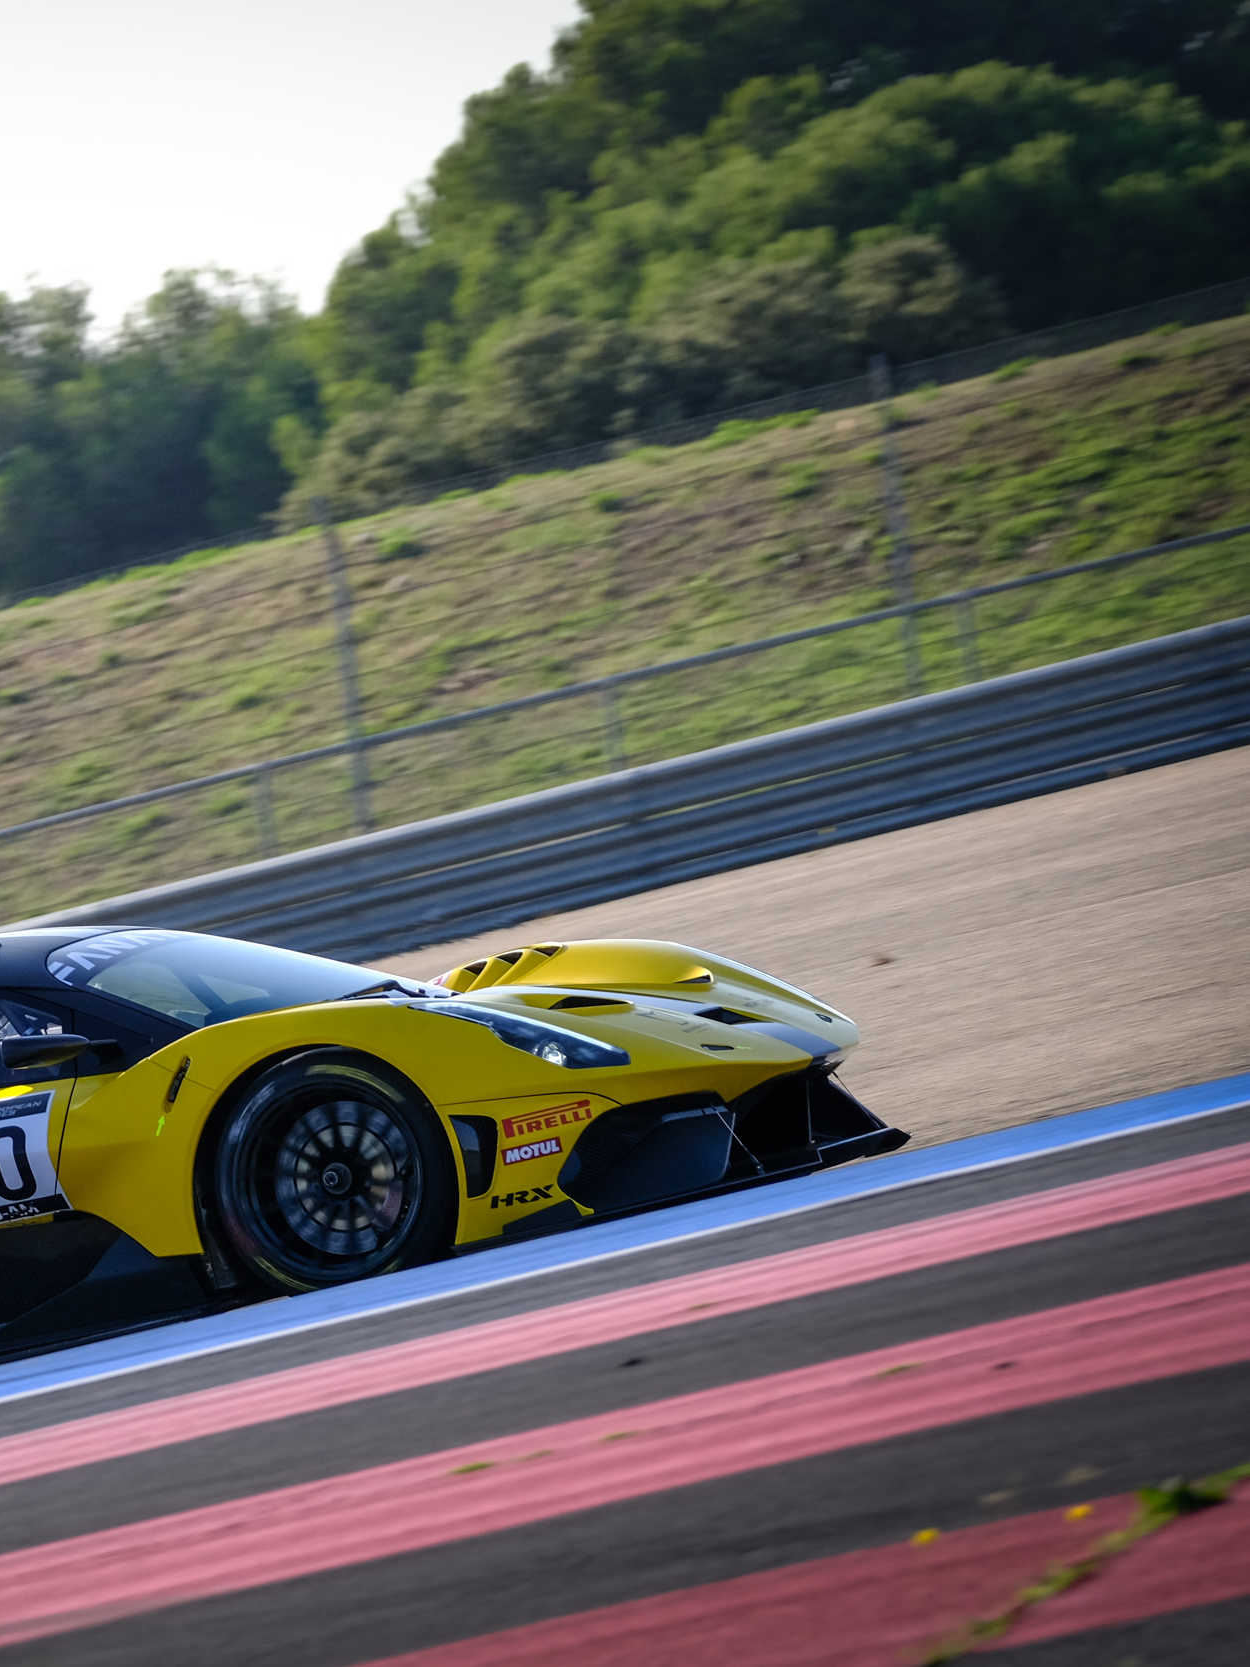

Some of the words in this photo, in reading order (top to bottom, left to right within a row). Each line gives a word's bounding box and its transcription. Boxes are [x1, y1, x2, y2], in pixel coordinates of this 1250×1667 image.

[502, 1099, 592, 1138] PIRELLI
[504, 1138, 561, 1164] MOTUL
[490, 1184, 554, 1208] HRX
